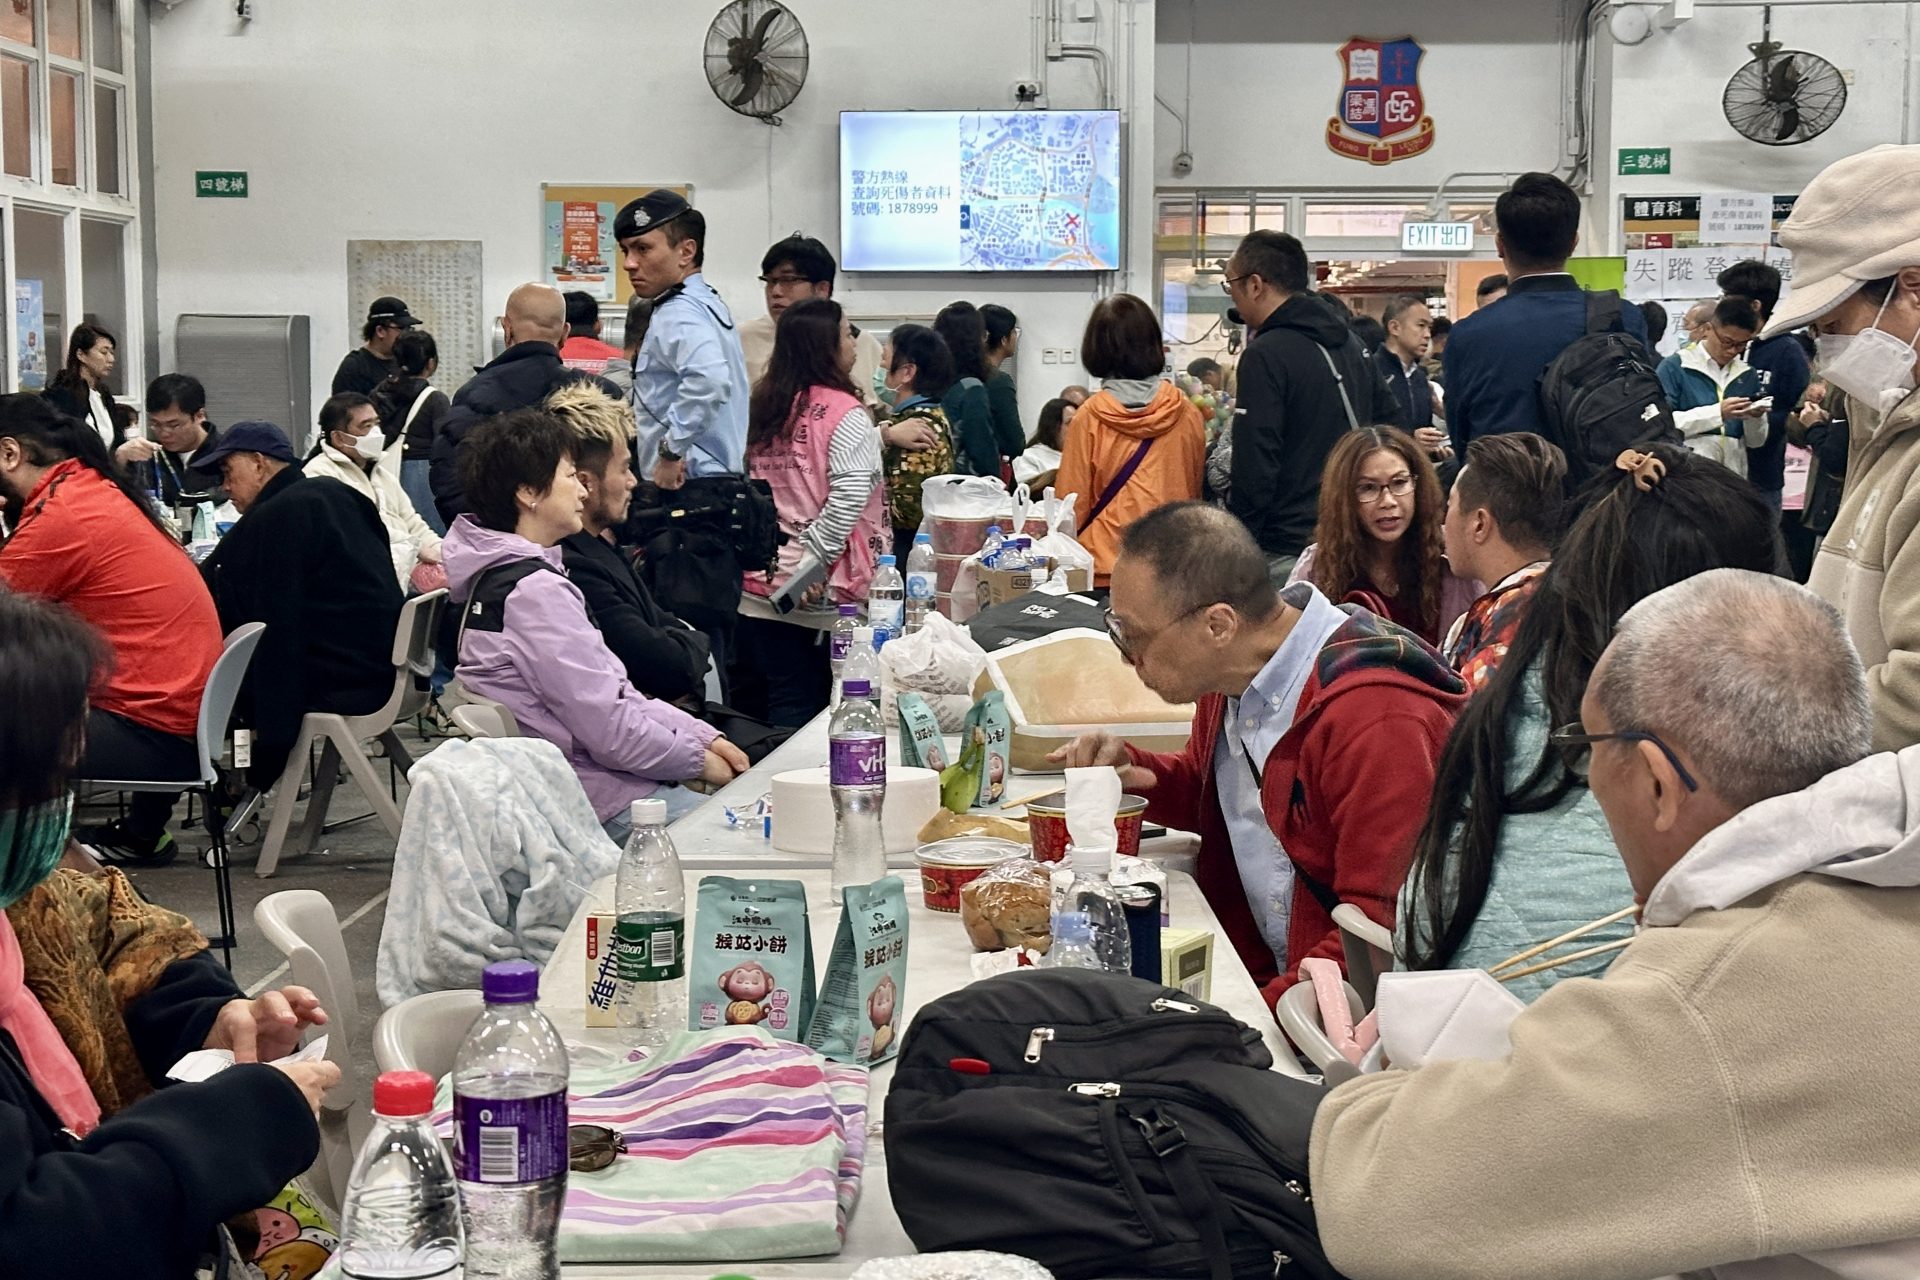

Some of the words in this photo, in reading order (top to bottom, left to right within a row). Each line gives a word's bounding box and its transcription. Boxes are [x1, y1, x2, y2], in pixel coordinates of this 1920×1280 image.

[1622, 153, 1667, 169] 三號梯
[199, 176, 245, 192] 四號梯
[852, 185, 951, 200] 查詢死傷者資料
[888, 203, 938, 214] 1878999
[1633, 200, 1683, 217] 體育科
[1408, 225, 1438, 246] EXIT
[1441, 225, 1467, 246] 出口
